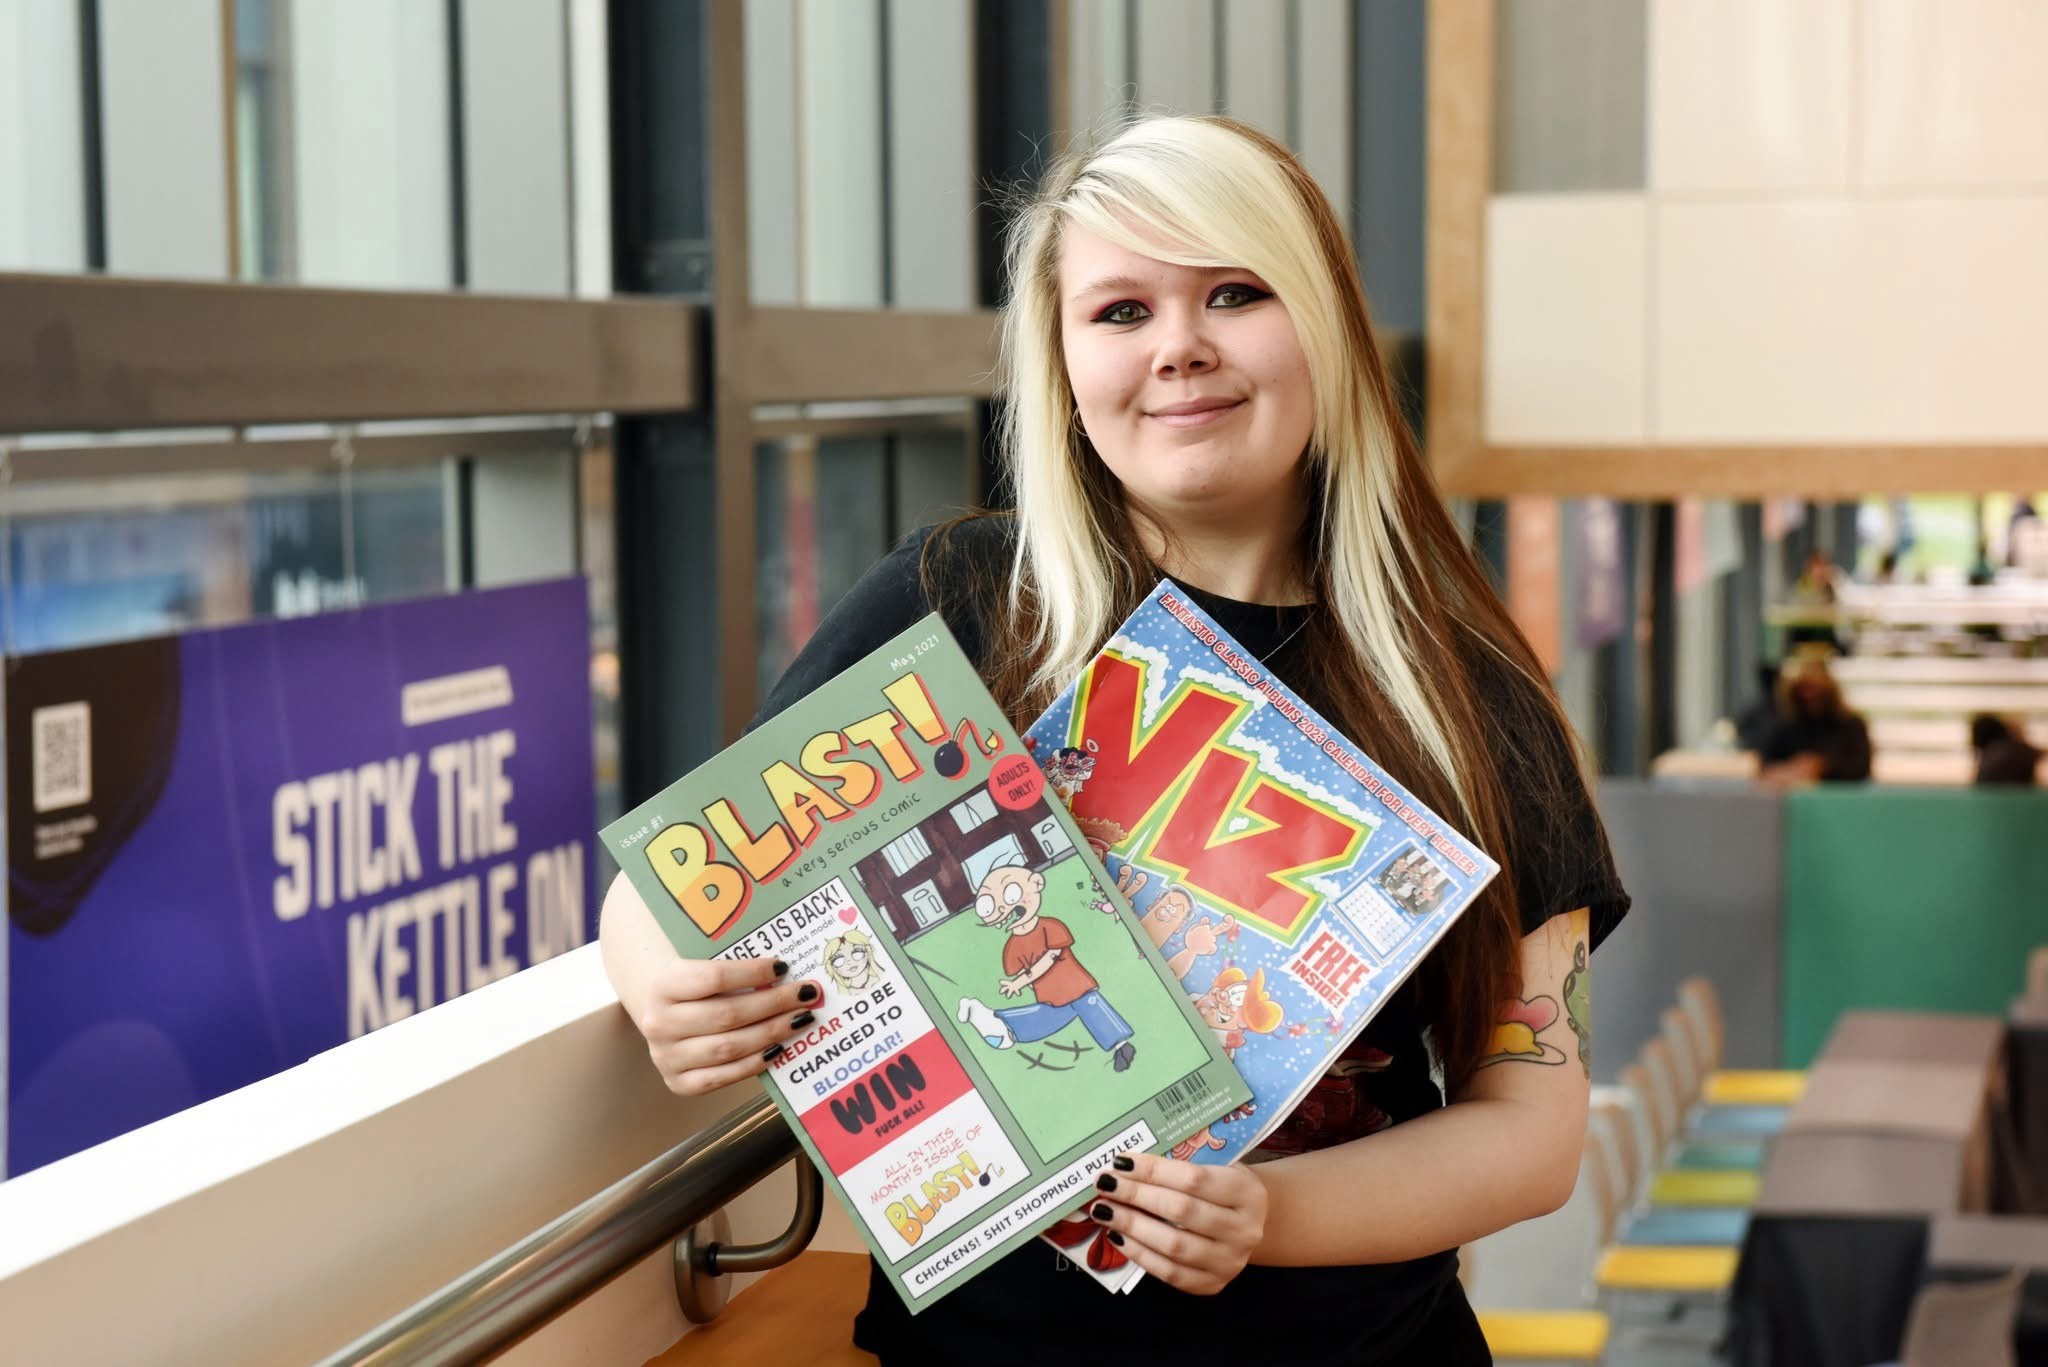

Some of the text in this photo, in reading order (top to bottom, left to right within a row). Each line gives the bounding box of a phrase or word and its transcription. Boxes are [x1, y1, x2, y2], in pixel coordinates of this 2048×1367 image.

[889, 634, 940, 672] May 2021
[1159, 592, 1480, 877] FANTASTIC CLASSIC ALBUMS 2023 CALENDAR FOR EVERY READER!
[644, 671, 951, 940] BLAST!
[996, 761, 1031, 787] ADULTS
[1008, 779, 1036, 802] ONLY!
[273, 731, 517, 921] STICK THE
[618, 824, 652, 849] issue
[782, 791, 922, 888] a very serious comic
[348, 843, 586, 1039] KETTLE ON
[757, 931, 773, 950] 3
[770, 918, 793, 942] IS
[790, 884, 844, 929] BACK!
[780, 915, 836, 955] topless model
[1291, 959, 1345, 1008] INSIDE!
[1302, 931, 1371, 998] FREE
[774, 983, 896, 1069] REDCAR TO BE
[789, 1005, 902, 1084] CHANGED TO
[813, 1031, 904, 1096] BLOOCAR!
[831, 1053, 926, 1135] WIN
[875, 1100, 924, 1137] FUCK ALL!
[885, 1127, 954, 1180] ALL IN THIS
[870, 1124, 983, 1205] MONTH'S ISSUE OF
[884, 1150, 982, 1246] BLAST!
[915, 1131, 1145, 1285] CHICKENS! SHIT SHOPPING! PUZZLES!
